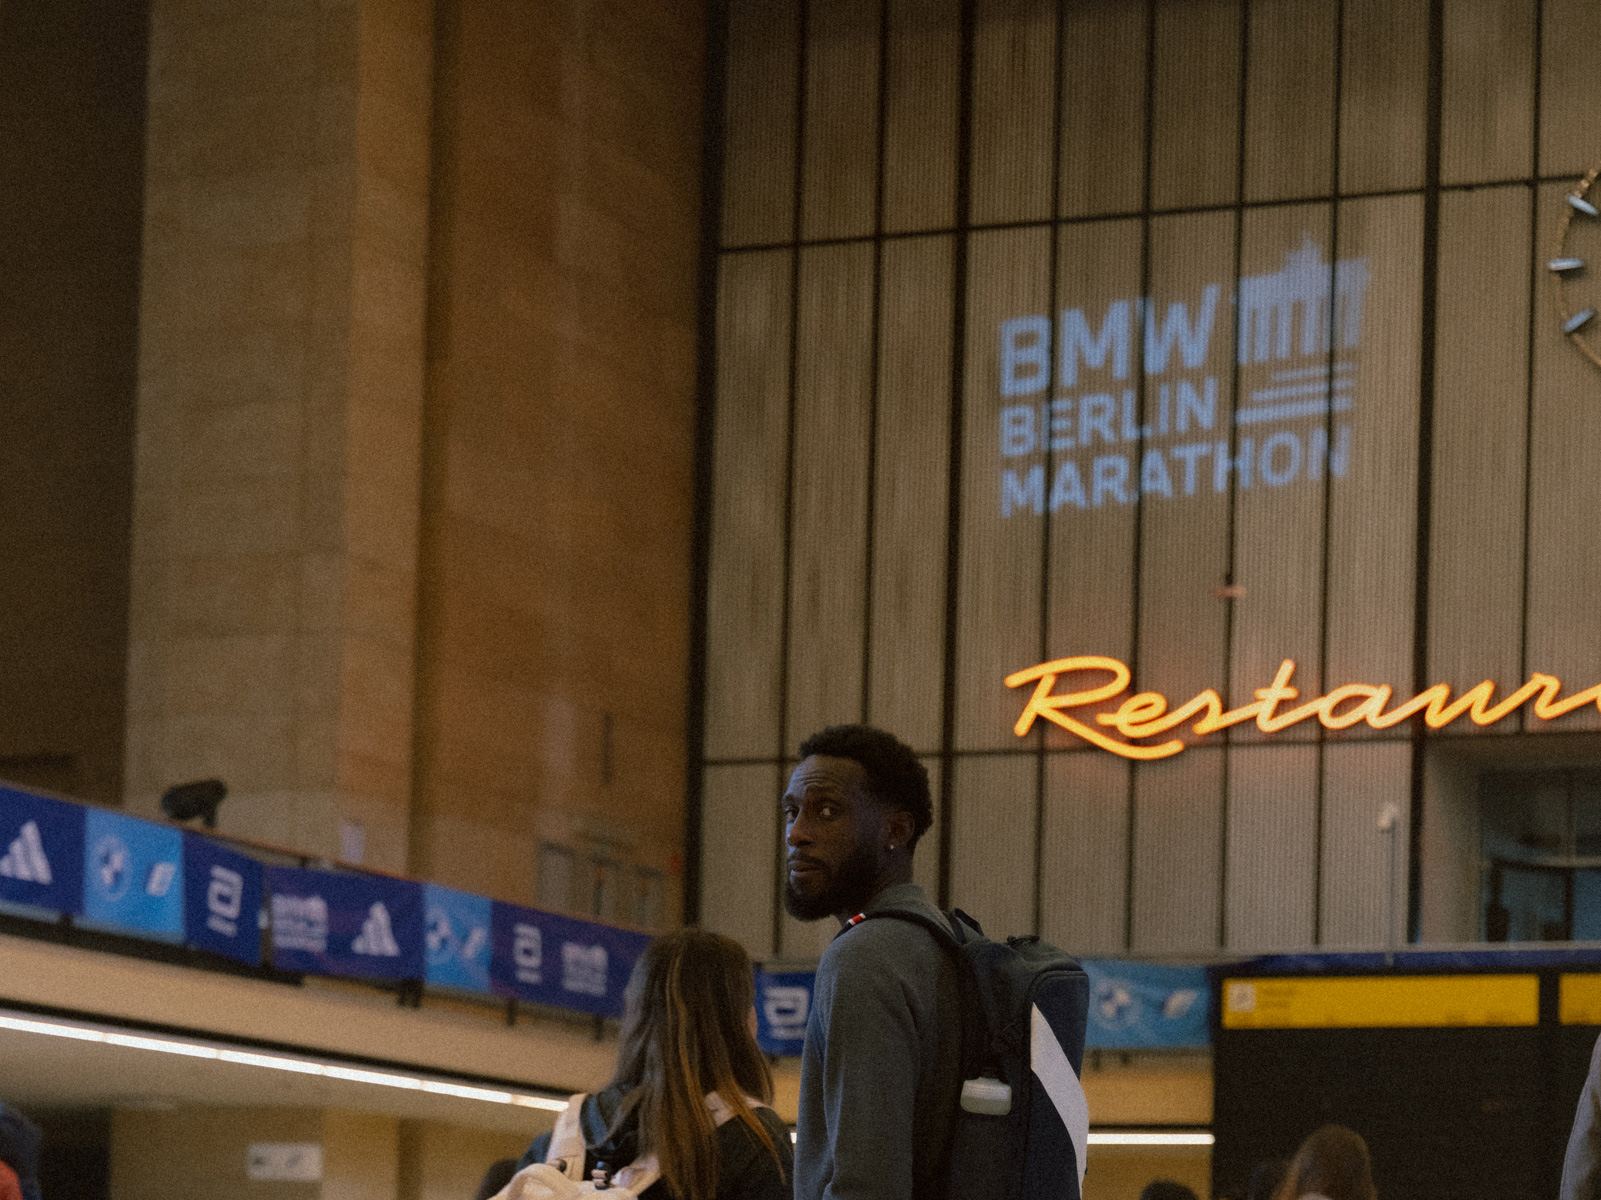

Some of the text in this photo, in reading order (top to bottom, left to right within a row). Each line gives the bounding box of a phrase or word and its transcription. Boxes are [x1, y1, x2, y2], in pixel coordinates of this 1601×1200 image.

[1000, 283, 1220, 397] BMW
[1000, 376, 1219, 458] BERLIN
[1000, 424, 1352, 518] MARATHON
[1004, 655, 1601, 760] Restaur
